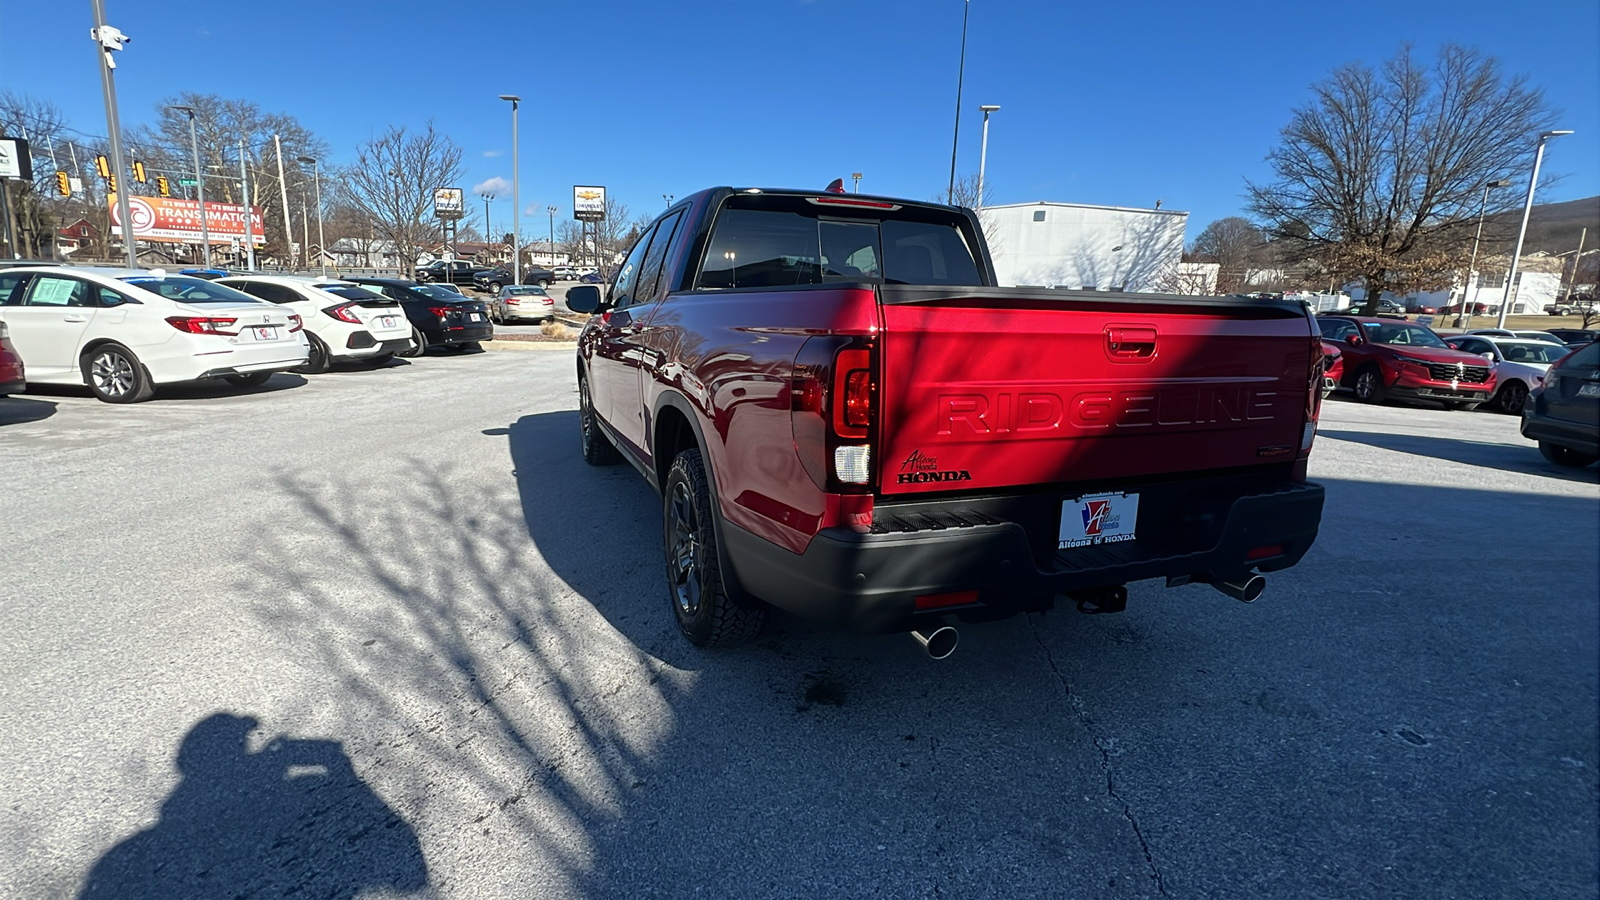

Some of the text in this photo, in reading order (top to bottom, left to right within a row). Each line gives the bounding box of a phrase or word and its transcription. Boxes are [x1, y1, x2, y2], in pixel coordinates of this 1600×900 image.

[937, 391, 1277, 434] RIDGELINE
[916, 462, 937, 470] Honda
[896, 470, 972, 484] HONDA
[1058, 539, 1091, 549] Altoona
[1104, 534, 1136, 543] HONDA
